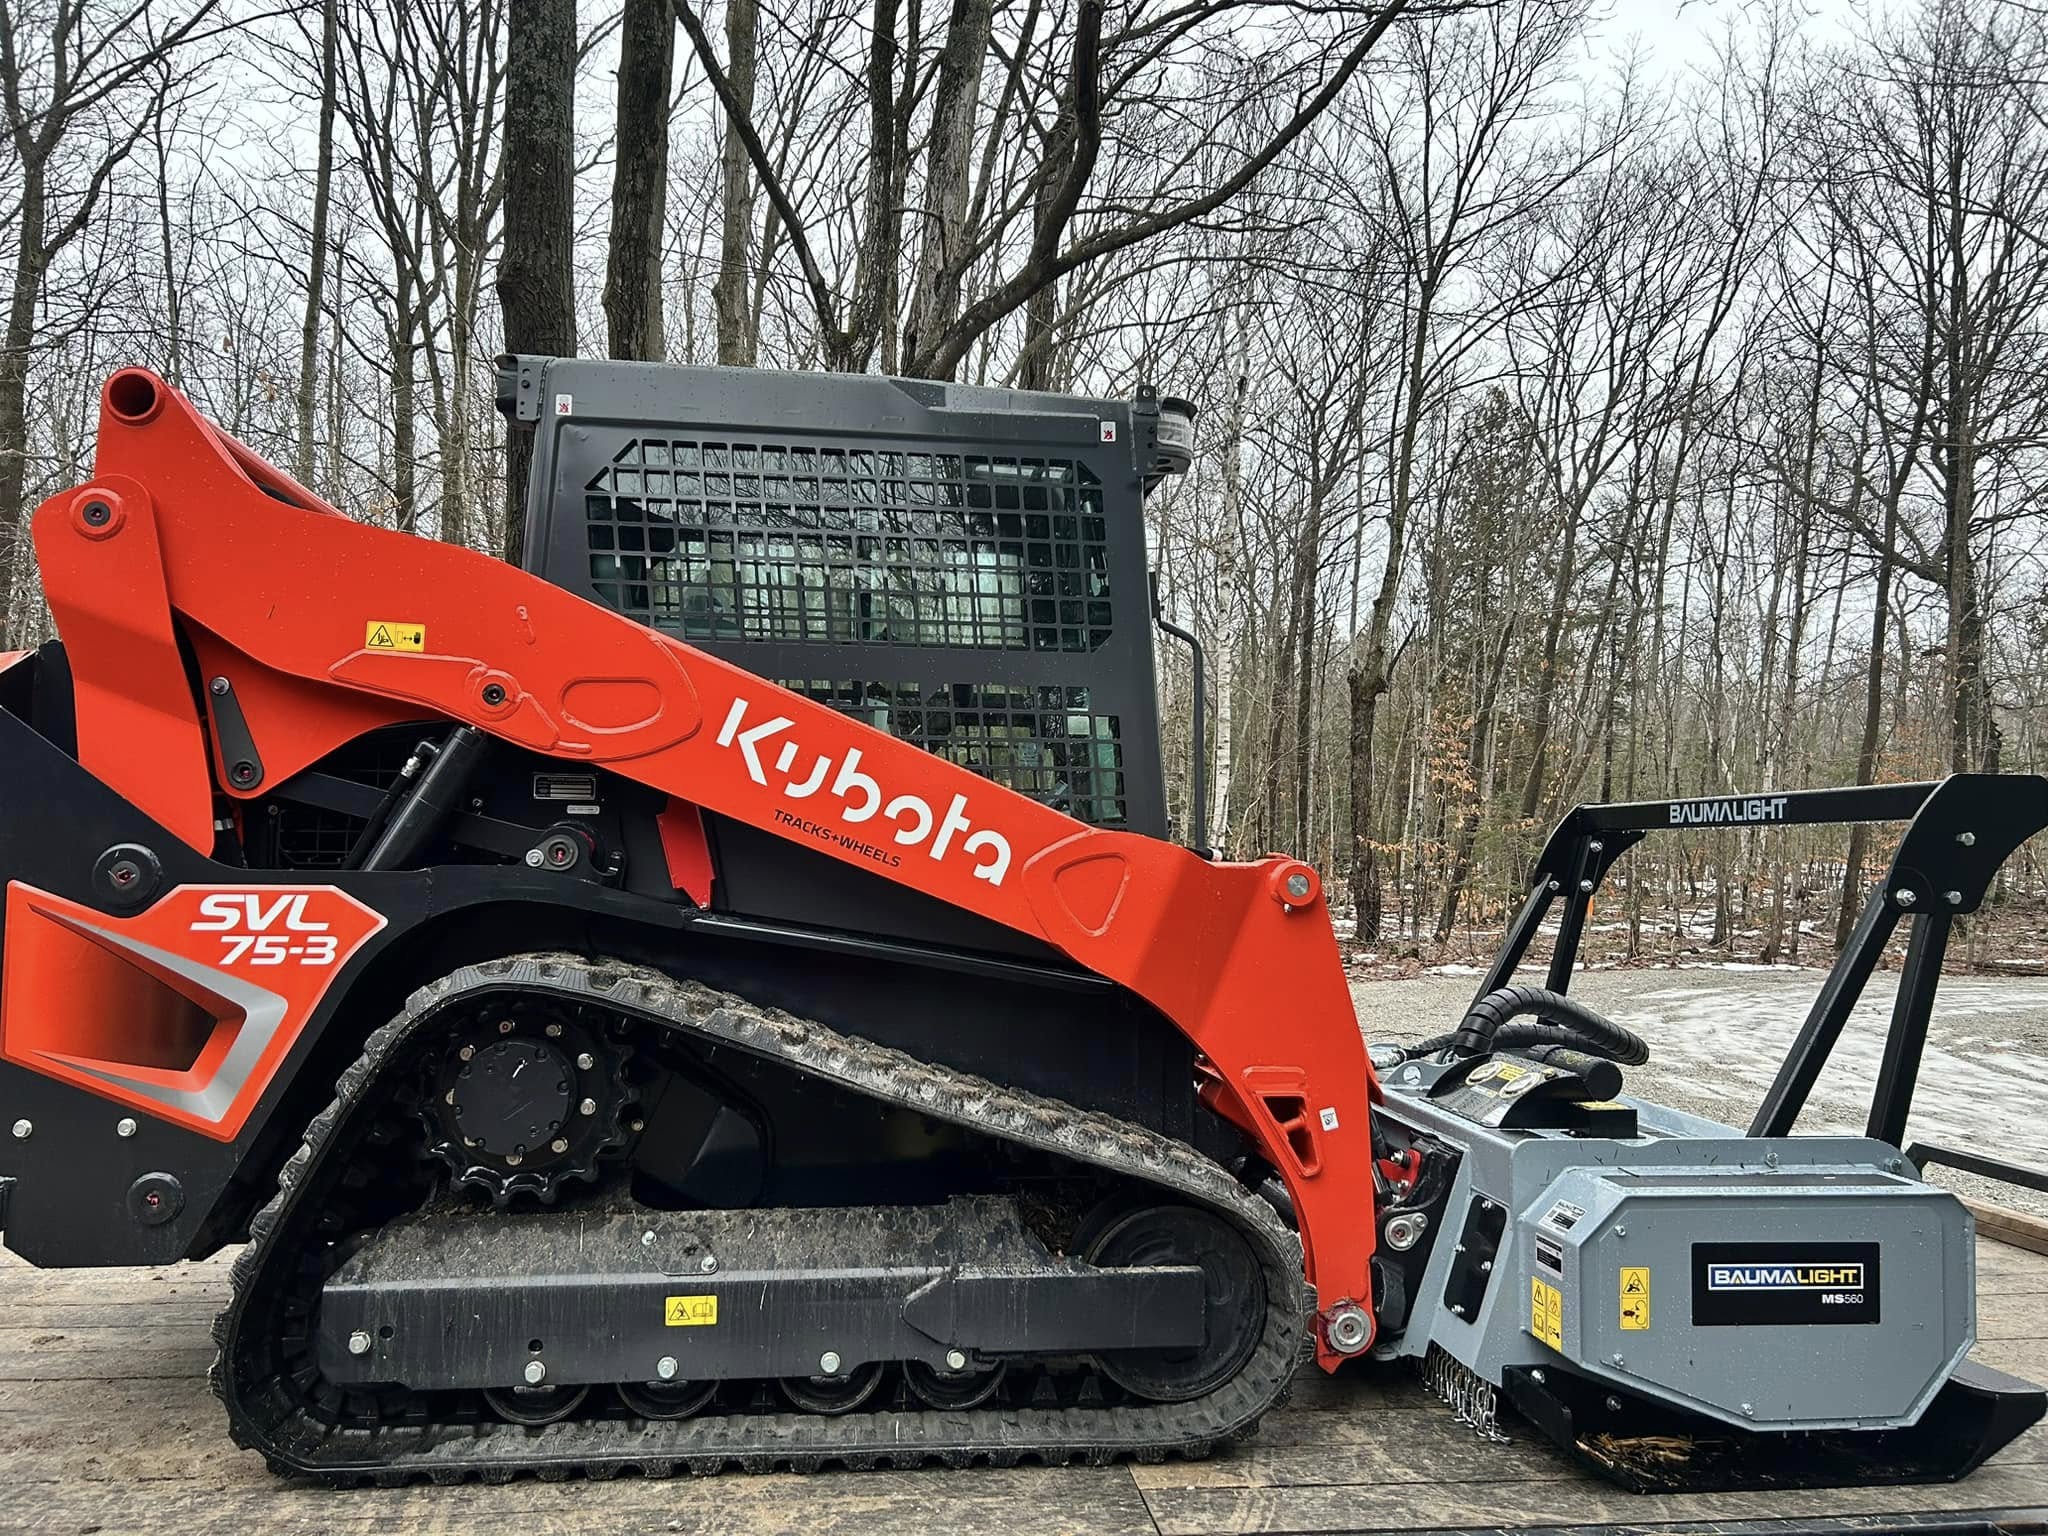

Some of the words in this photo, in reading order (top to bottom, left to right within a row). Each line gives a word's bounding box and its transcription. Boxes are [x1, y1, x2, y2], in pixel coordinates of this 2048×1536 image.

[716, 697, 1012, 886] Kubota
[1669, 798, 1787, 824] BAUMALIGHT
[774, 808, 901, 867] TRACKS+WHEELS
[189, 894, 330, 931] SVL
[218, 935, 338, 966] 75-3
[1714, 1268, 1858, 1285] BAUMALIGHT
[1822, 1294, 1864, 1304] MS560
